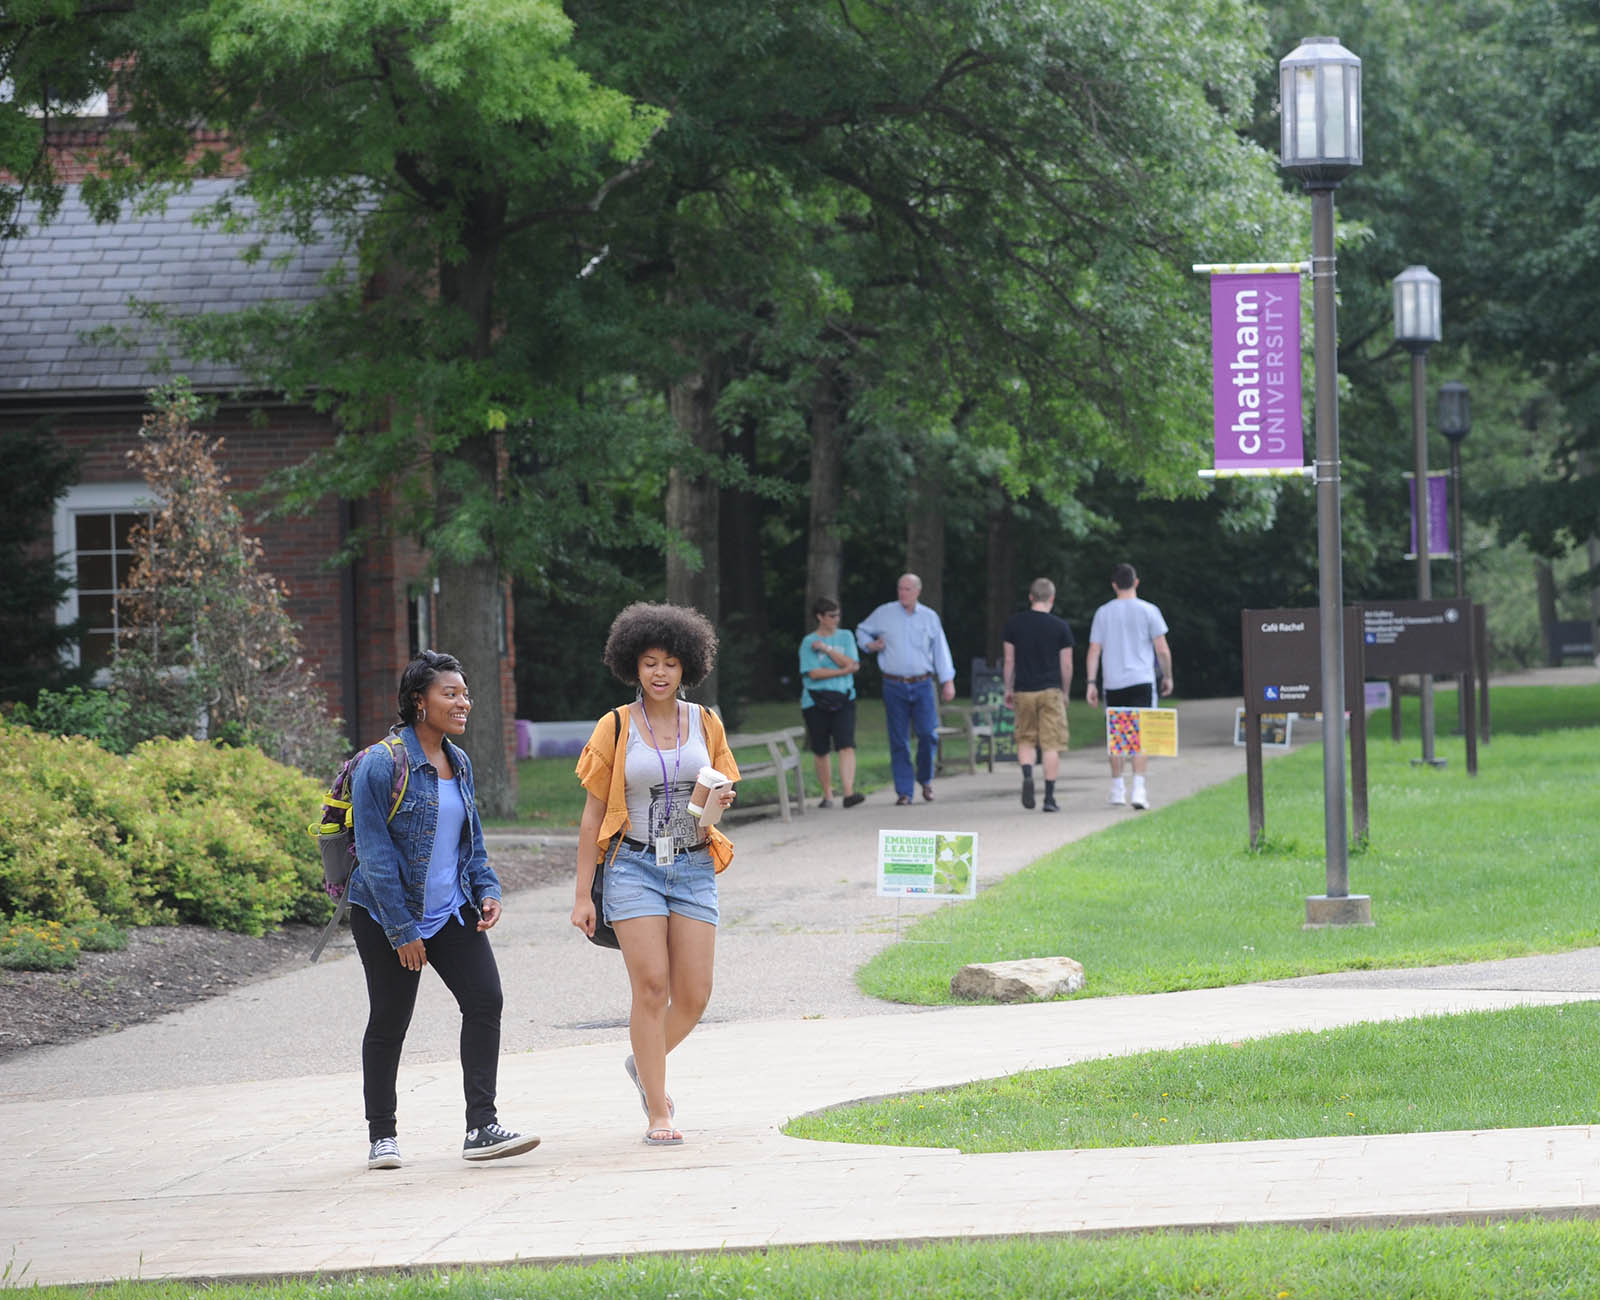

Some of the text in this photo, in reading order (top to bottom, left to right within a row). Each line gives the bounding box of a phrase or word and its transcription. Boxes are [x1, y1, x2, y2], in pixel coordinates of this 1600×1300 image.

[1230, 289, 1261, 455] chatham
[1265, 290, 1286, 454] UNIVERSITY
[1279, 622, 1304, 632] Rachel
[884, 844, 934, 854] LEADERS
